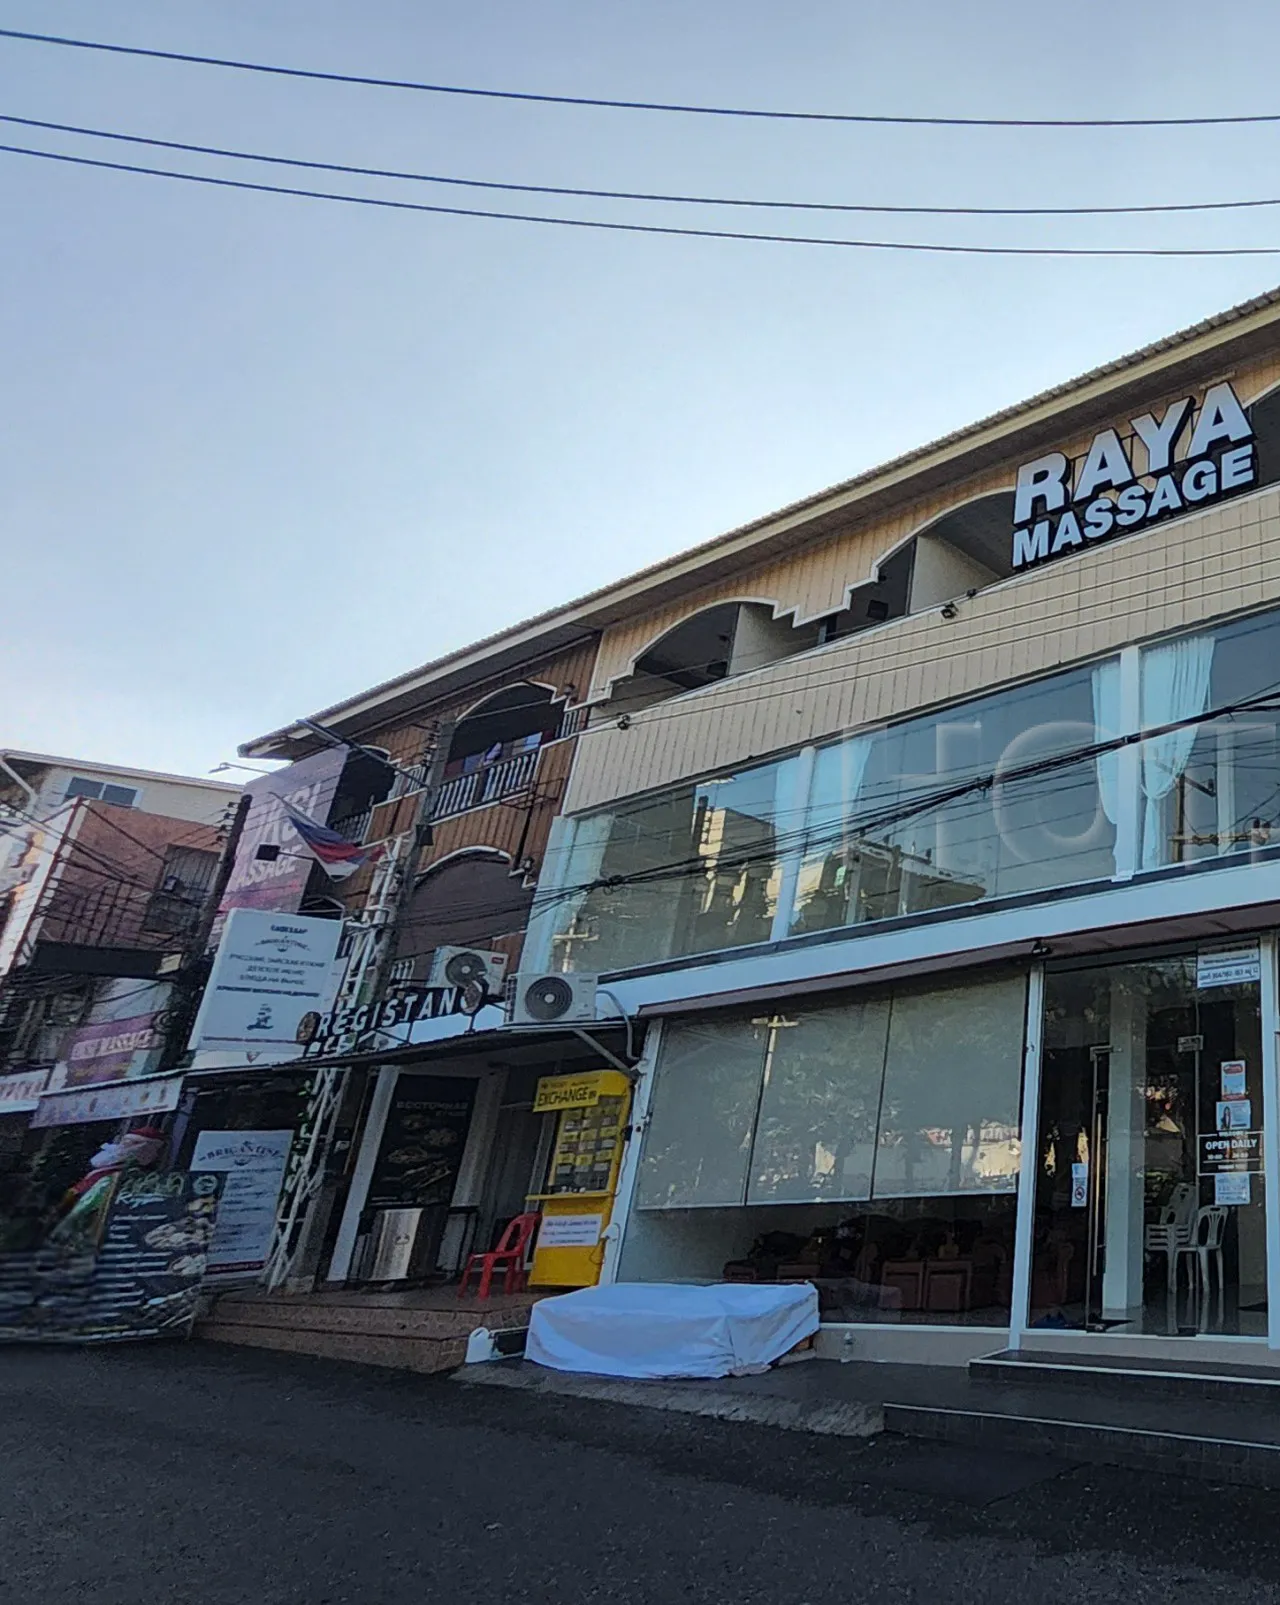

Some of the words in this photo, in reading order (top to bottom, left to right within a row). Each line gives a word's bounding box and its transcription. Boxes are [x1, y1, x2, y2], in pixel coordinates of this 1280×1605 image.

[1013, 381, 1253, 525] RAYA
[1012, 443, 1254, 568] MASSAGE
[316, 987, 457, 1038] REGISTAN
[538, 1086, 588, 1107] EXCHANGE
[1205, 1141, 1230, 1150] OPEN
[1231, 1138, 1257, 1149] DAILY
